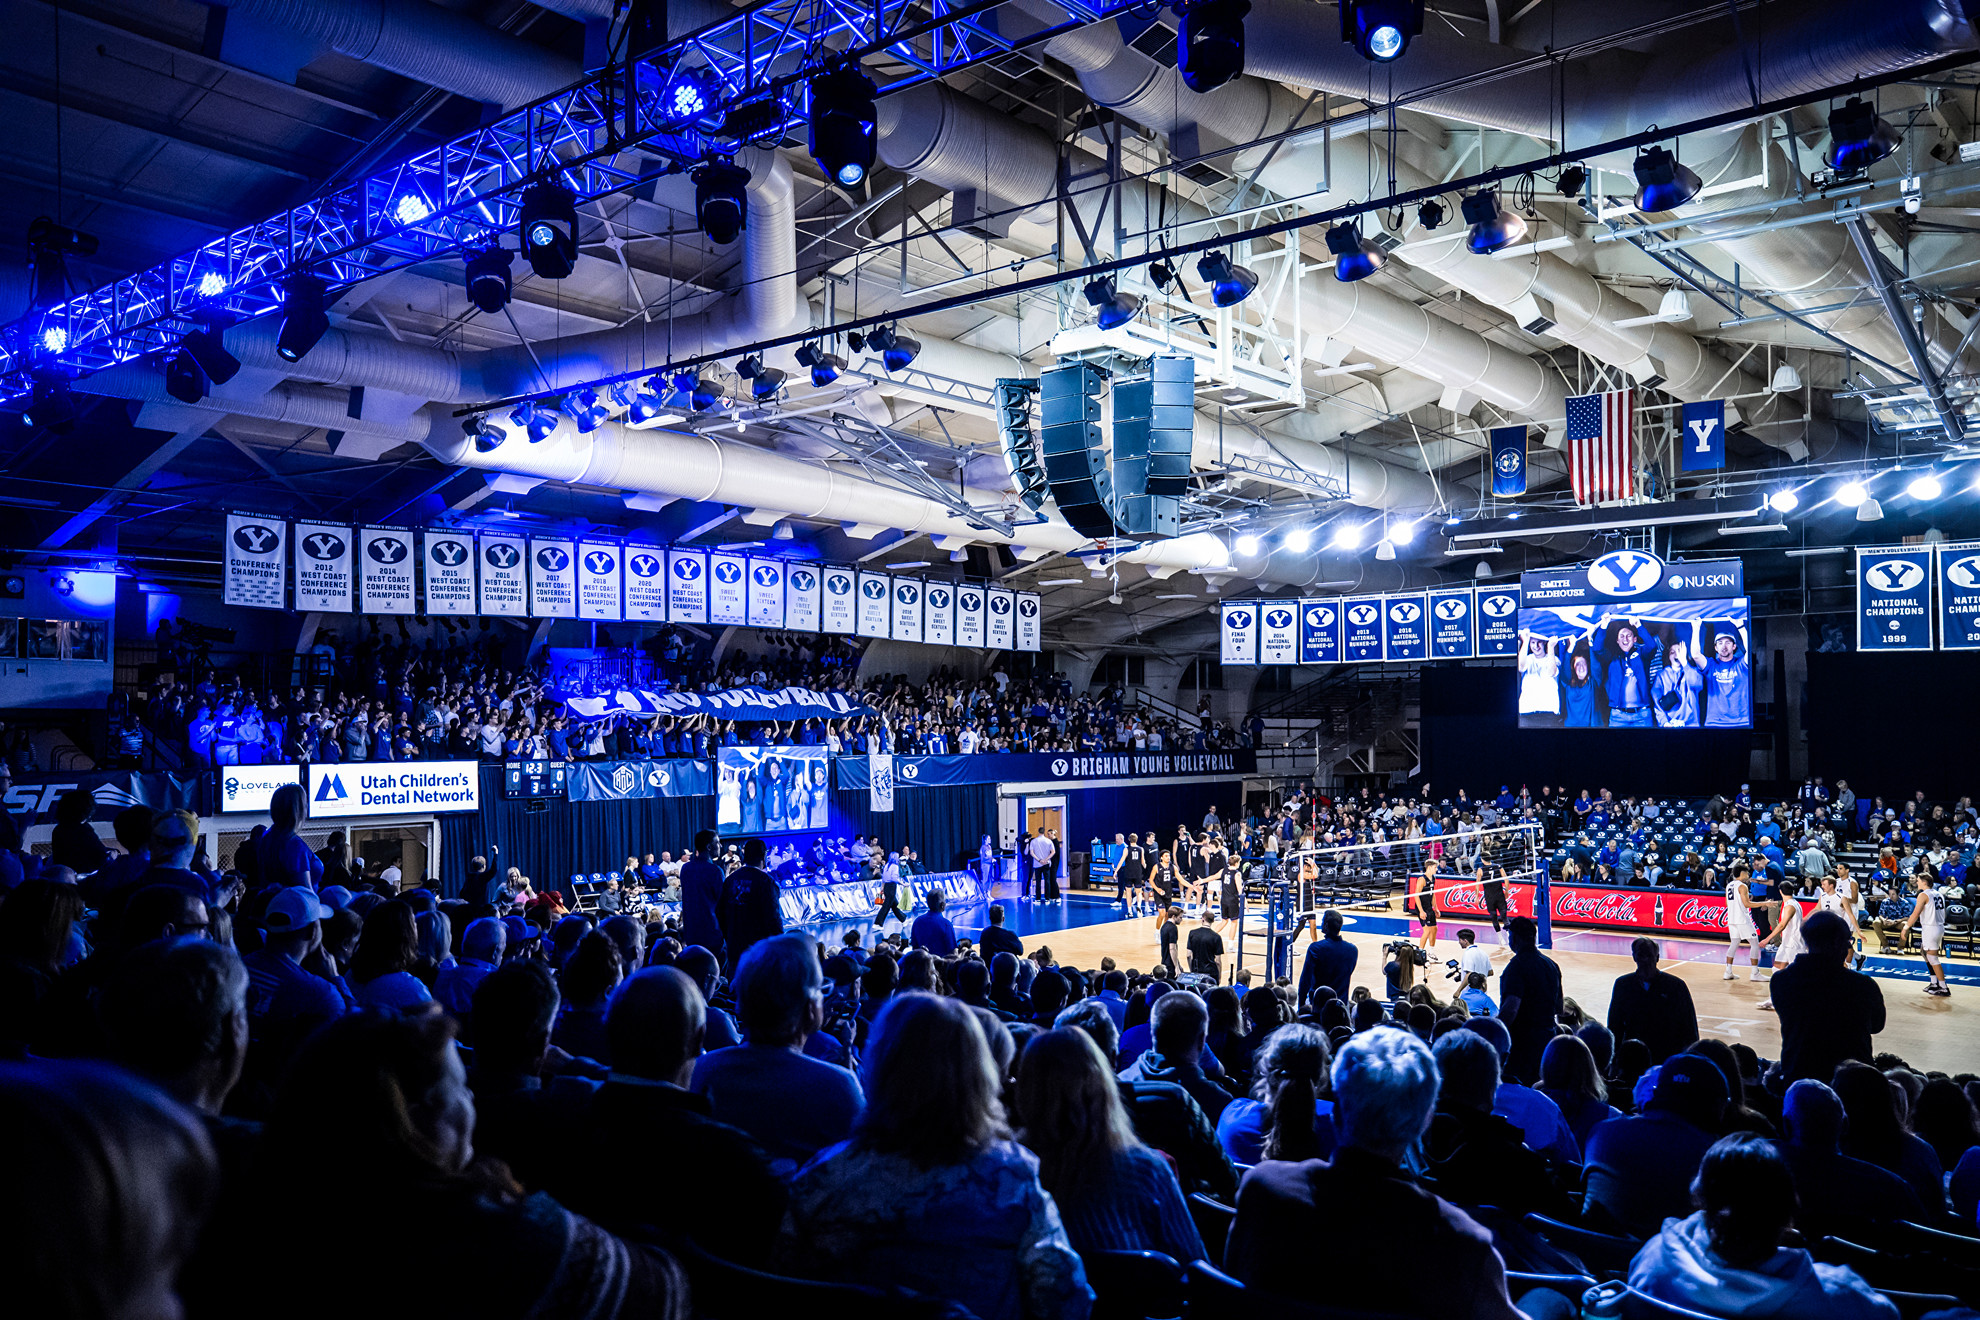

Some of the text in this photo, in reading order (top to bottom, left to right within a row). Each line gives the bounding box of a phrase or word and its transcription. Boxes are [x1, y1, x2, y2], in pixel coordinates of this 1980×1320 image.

[1689, 418, 1718, 452] Y
[241, 528, 272, 551] Y
[309, 535, 338, 557] Y
[374, 540, 400, 561] Y
[437, 543, 461, 564] Y
[491, 546, 514, 566] Y
[231, 559, 280, 570] CONFERENCE
[542, 550, 564, 569] Y
[589, 553, 610, 572] Y
[635, 557, 655, 575] Y
[232, 568, 279, 578] CHAMPIONS
[678, 560, 697, 578] Y
[720, 564, 737, 582] Y
[758, 568, 775, 585] Y
[1598, 555, 1650, 592] Y
[1876, 564, 1914, 588] Y
[301, 580, 347, 588] CONFERENCE
[795, 573, 812, 589] Y
[831, 577, 847, 593] Y
[1541, 580, 1570, 588] SMITH
[1685, 574, 1734, 587] NU SKIN
[867, 582, 882, 598] Y
[901, 587, 915, 602] Y
[1526, 589, 1585, 599] FIELDHOUSE
[933, 591, 946, 606] Y
[964, 595, 977, 610] Y
[994, 598, 1007, 613] Y
[1489, 598, 1510, 614] Y
[1872, 599, 1918, 607] NATIONAL
[1022, 601, 1034, 616] Y
[1353, 608, 1372, 622] Y
[1395, 606, 1415, 621] Y
[1441, 602, 1460, 617] Y
[1866, 607, 1924, 616] CHAMPIONS
[1231, 612, 1248, 627] Y
[1270, 611, 1288, 626] Y
[1311, 610, 1329, 625] Y
[905, 766, 915, 776] Y
[1073, 757, 1129, 776] BRIGHAM
[1134, 756, 1170, 773] YOUNG
[1174, 754, 1234, 772] VOLLEYBALL
[361, 773, 468, 789] Utah Children's
[513, 771, 519, 782] 0
[557, 770, 563, 781] 0
[652, 773, 665, 784] Y
[533, 782, 538, 793] 3
[361, 788, 473, 805] Dental Network
[1132, 851, 1138, 859] 10
[1489, 871, 1494, 880] 7
[1556, 891, 1641, 921] Coca-Cola
[1676, 898, 1728, 927] Coca-C
